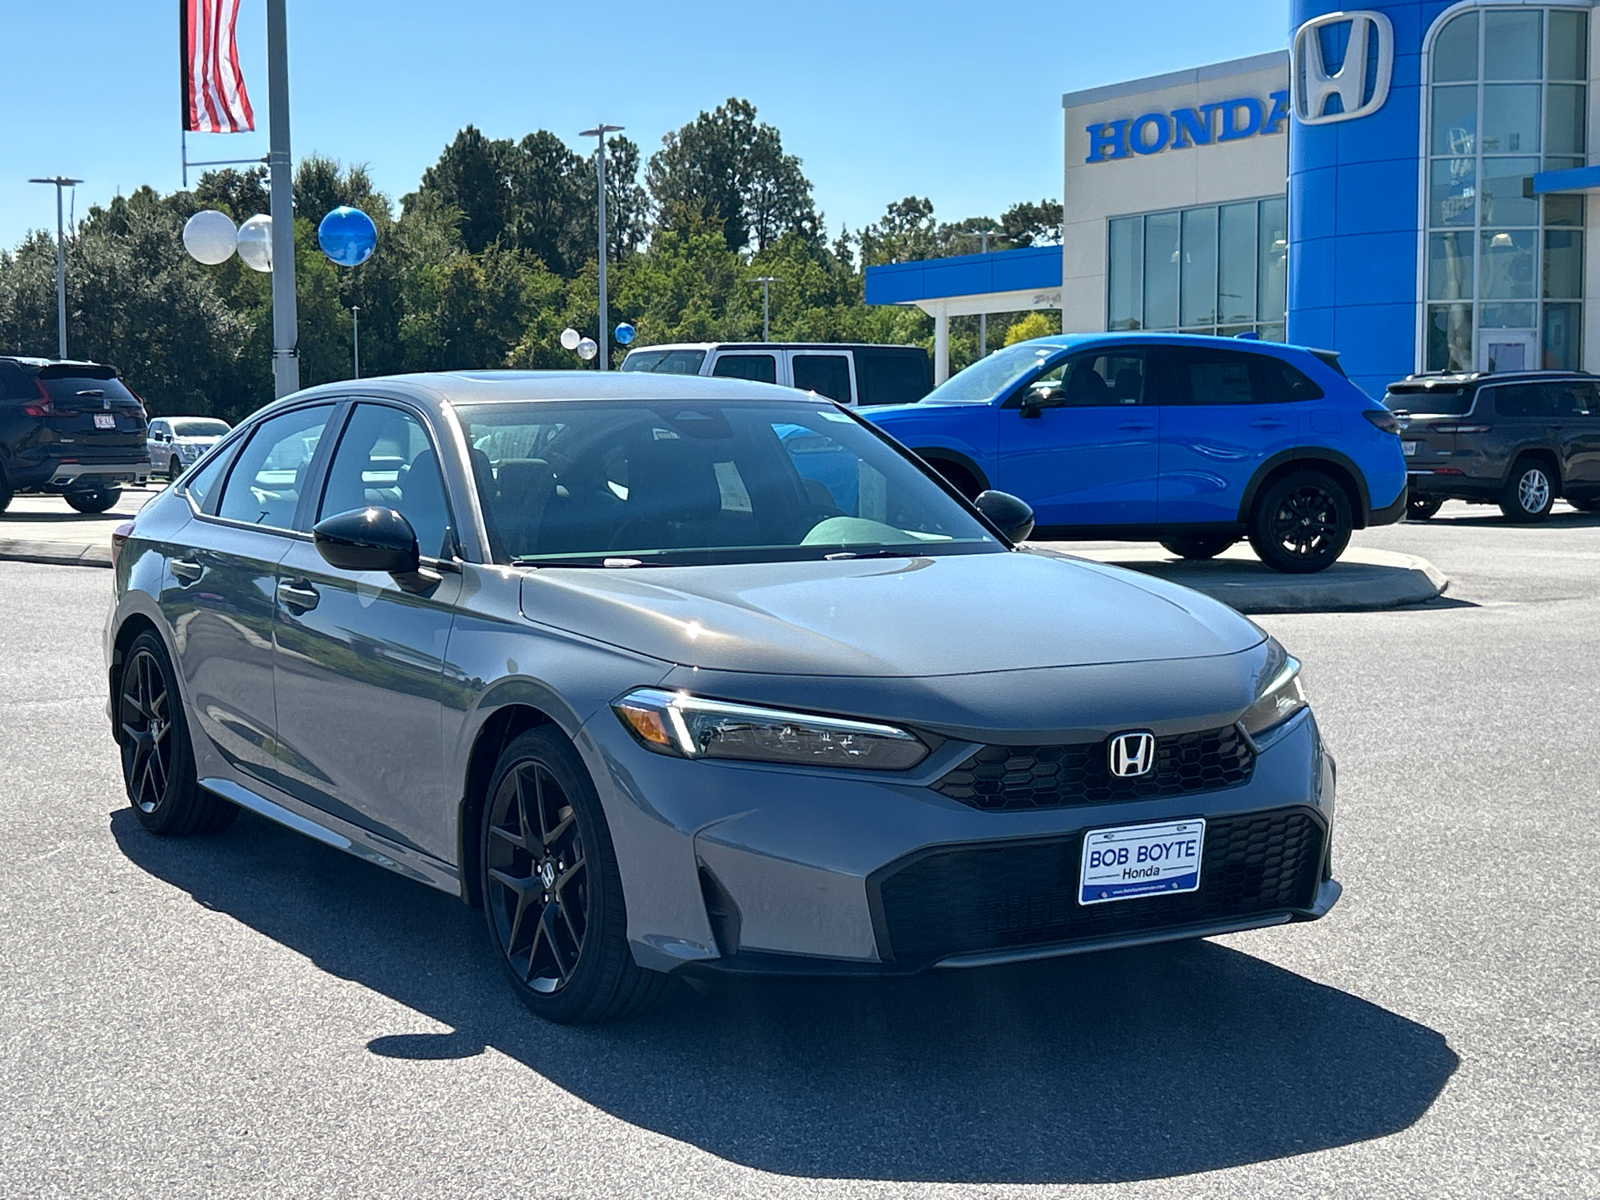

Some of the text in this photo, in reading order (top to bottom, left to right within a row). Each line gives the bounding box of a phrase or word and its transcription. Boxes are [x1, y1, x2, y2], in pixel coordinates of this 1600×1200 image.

[1090, 839, 1197, 869] BOB BOYTE
[1122, 865, 1160, 880] Honda
